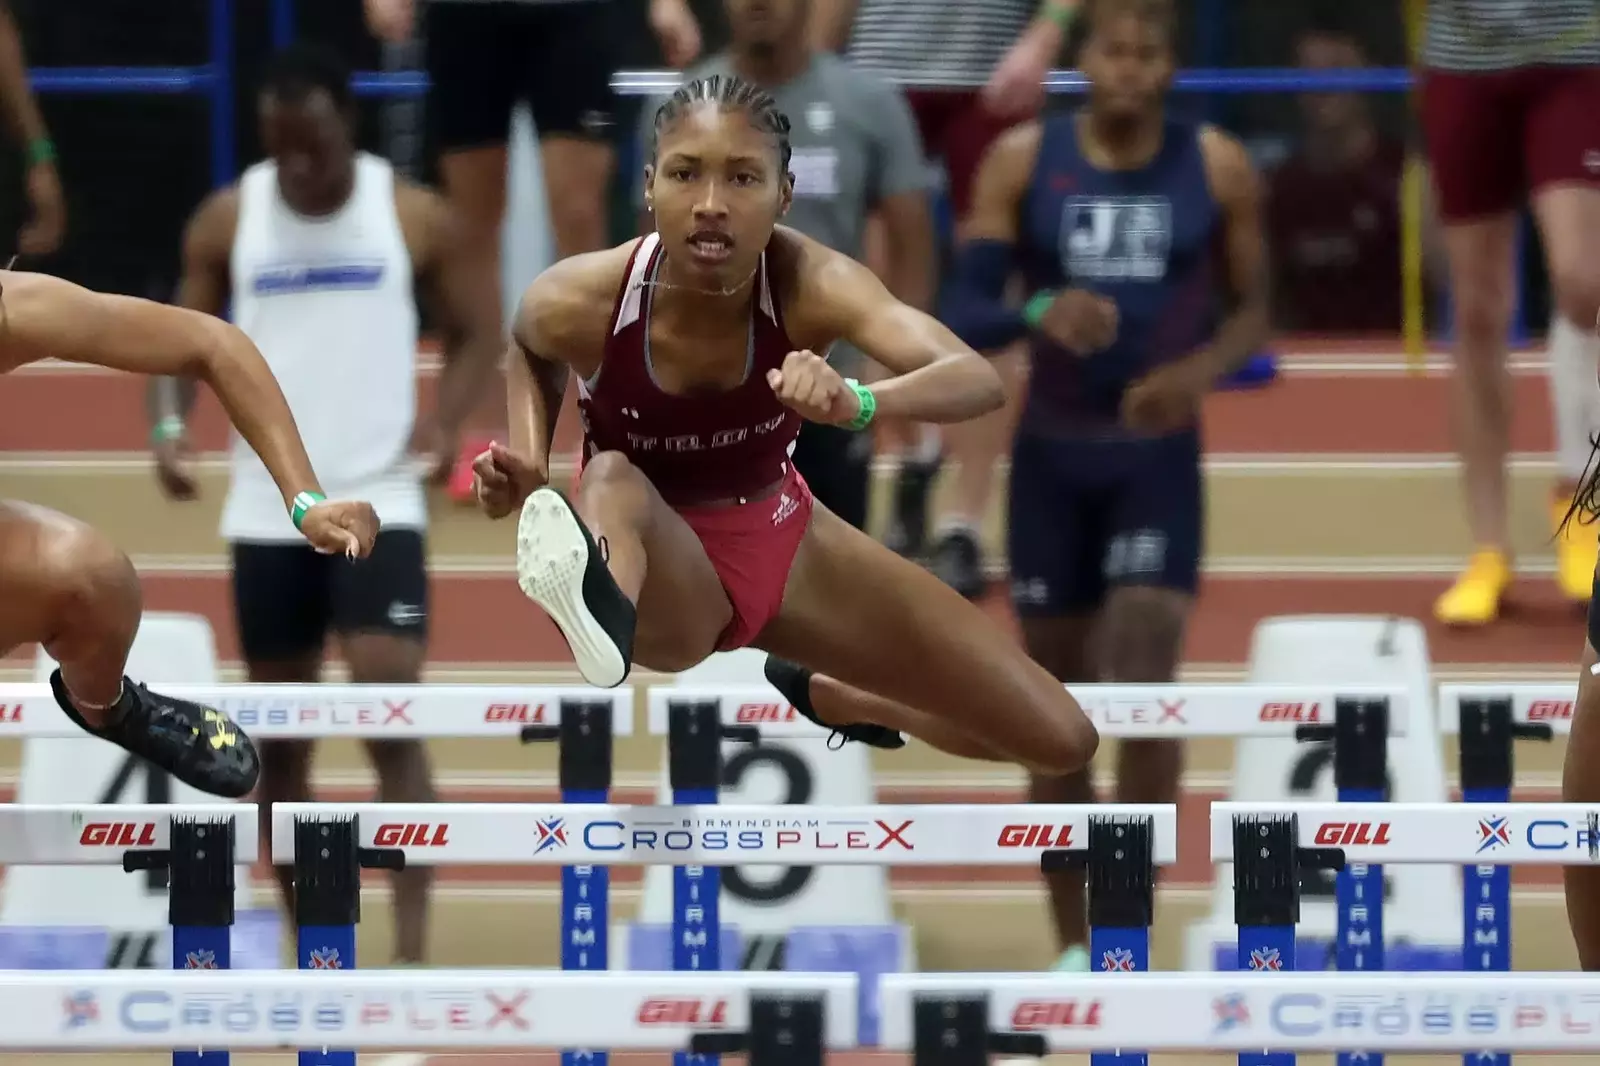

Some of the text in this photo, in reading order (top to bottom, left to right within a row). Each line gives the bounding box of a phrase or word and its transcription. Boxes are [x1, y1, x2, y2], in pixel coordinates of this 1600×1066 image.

[627, 411, 786, 452] TROY
[485, 703, 546, 723] GILL
[1259, 702, 1322, 723] GILL
[80, 823, 156, 846] GILL
[373, 823, 449, 846] GILL
[583, 819, 915, 851] CROSSPLEX
[682, 819, 820, 828] BIRMINGHAM
[997, 822, 1074, 847] GILL
[1314, 822, 1391, 845] GILL
[637, 998, 728, 1026] GILL
[1012, 998, 1102, 1030] GILL
